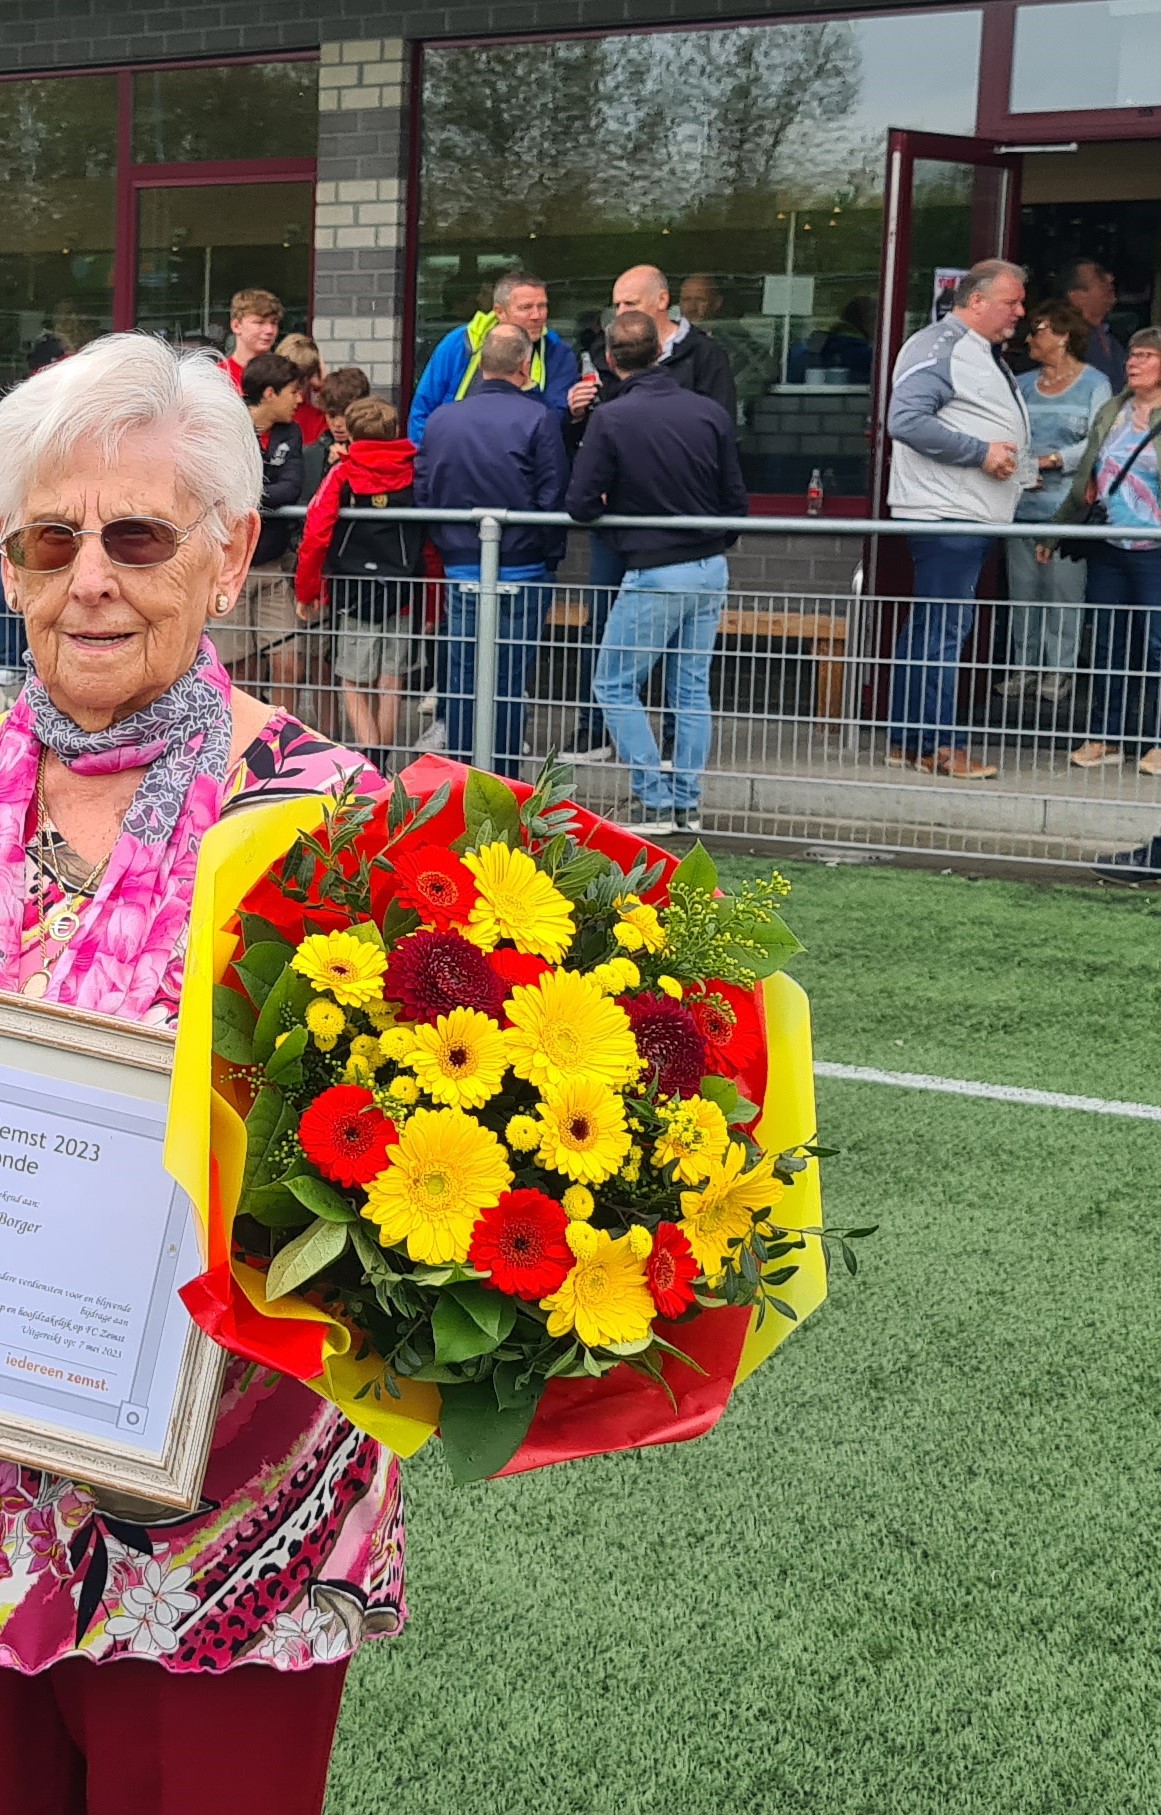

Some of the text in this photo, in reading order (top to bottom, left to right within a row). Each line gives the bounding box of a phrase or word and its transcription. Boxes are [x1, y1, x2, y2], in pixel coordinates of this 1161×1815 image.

[52, 1135, 101, 1162] 2023
[18, 1278, 64, 1297] verdiensten
[65, 1290, 84, 1300] voor
[83, 1296, 94, 1304] en
[95, 1296, 132, 1313] blijvende
[6, 1306, 16, 1314] en
[17, 1306, 73, 1331] hoofdzakelijk
[72, 1323, 84, 1334] op
[84, 1324, 99, 1337] FC
[98, 1328, 126, 1343] Zemst
[80, 1306, 129, 1327] bijdrage aan
[21, 1324, 62, 1345] Uitgereikt
[85, 1343, 100, 1354] mei
[5, 1351, 109, 1392] iedereen zemst.
